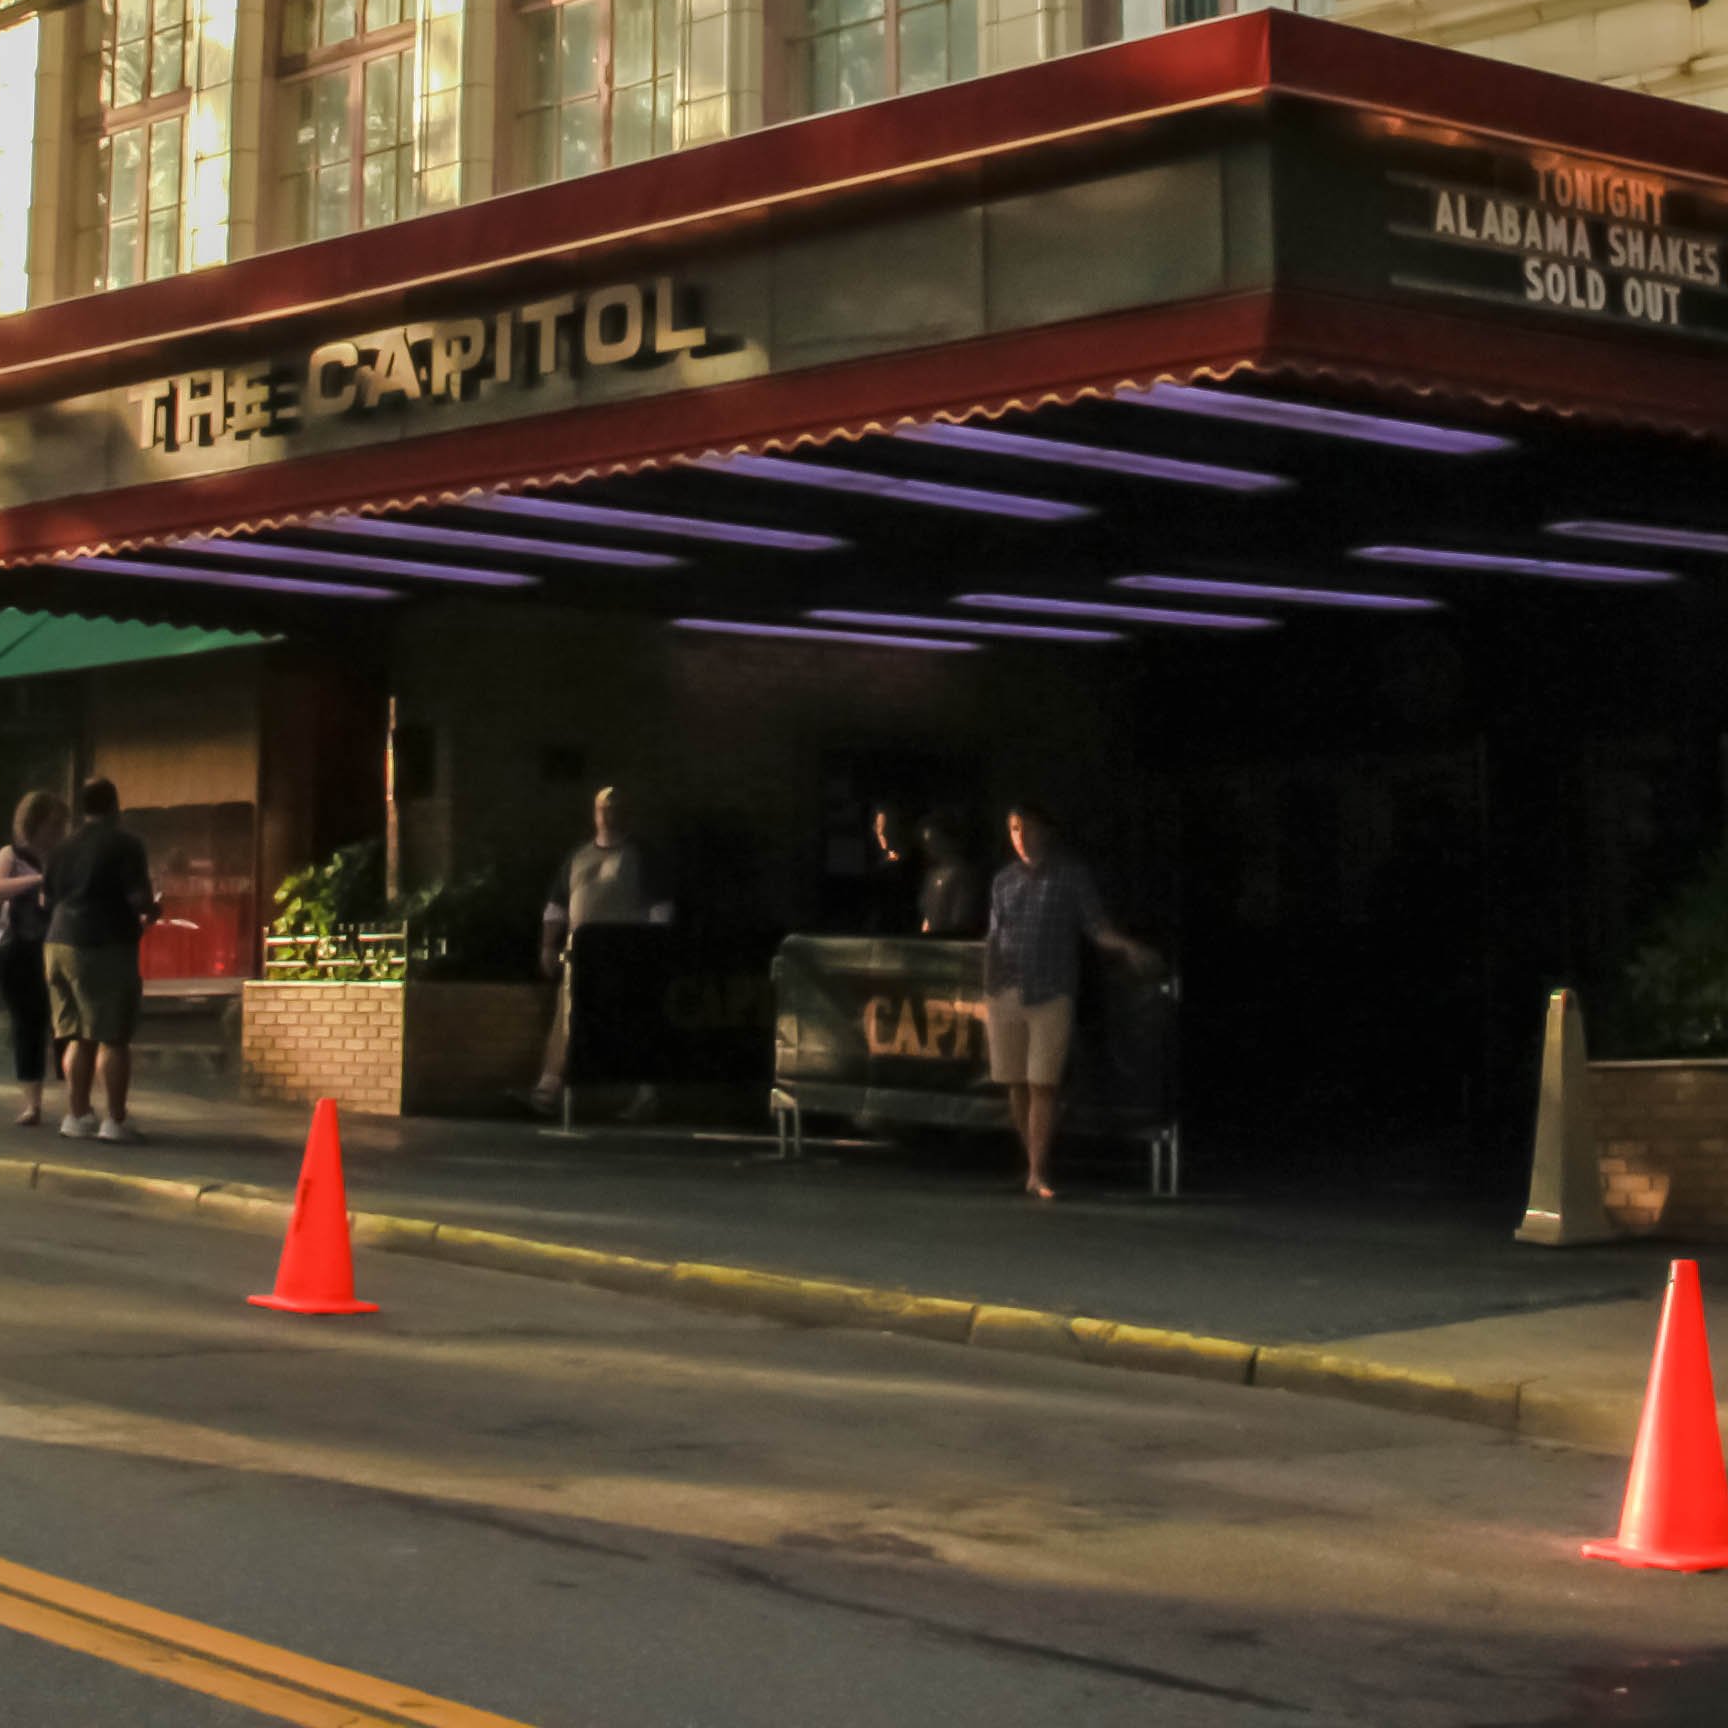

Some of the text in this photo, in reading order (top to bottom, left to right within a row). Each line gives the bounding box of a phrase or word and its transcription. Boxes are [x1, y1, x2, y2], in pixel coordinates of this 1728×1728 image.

[1537, 166, 1665, 225] TONIGHT
[1435, 190, 1721, 287] ALABAMA SHAKES
[1524, 256, 1681, 325] SOLD OUT
[128, 276, 708, 451] THE CAPITOL
